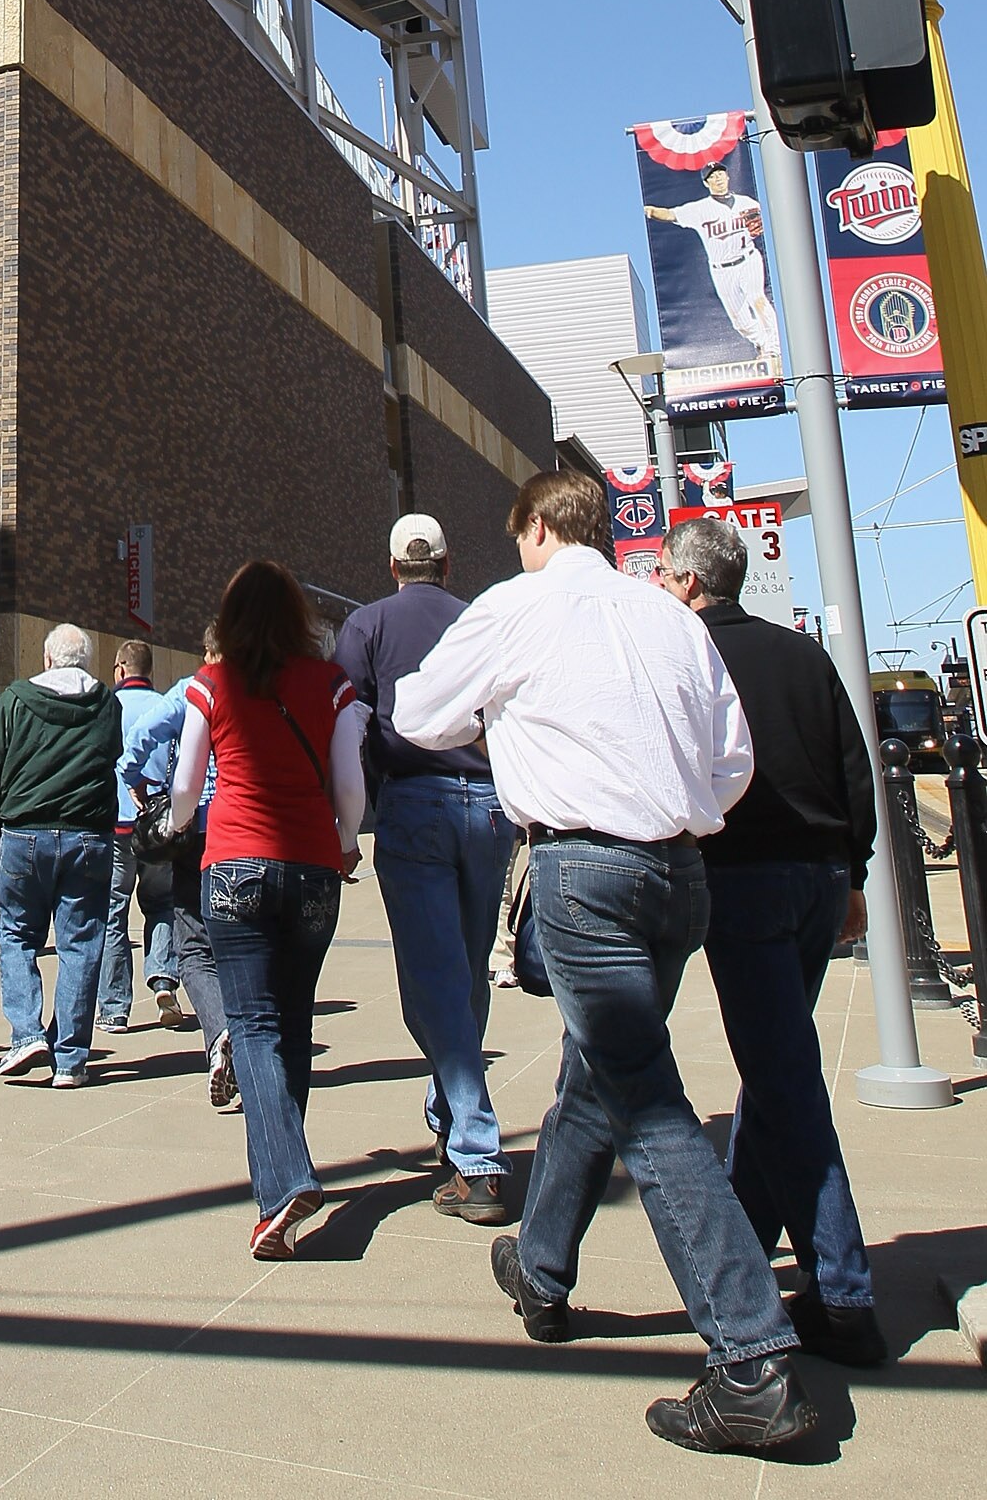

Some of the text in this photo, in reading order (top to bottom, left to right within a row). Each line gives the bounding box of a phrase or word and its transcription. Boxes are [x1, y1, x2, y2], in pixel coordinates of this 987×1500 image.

[741, 236, 746, 249] 1
[858, 283, 879, 305] WORLD
[878, 277, 907, 288] SERIES
[884, 330, 935, 353] ANNIVERSARY
[681, 361, 769, 385] NISHIOKA
[851, 379, 946, 394] TARGET FIE
[672, 395, 779, 412] TARGET FIELD
[761, 531, 781, 561] 3
[130, 541, 141, 610] TICKETS
[764, 571, 777, 581] 14
[745, 584, 785, 594] 29 & 34
